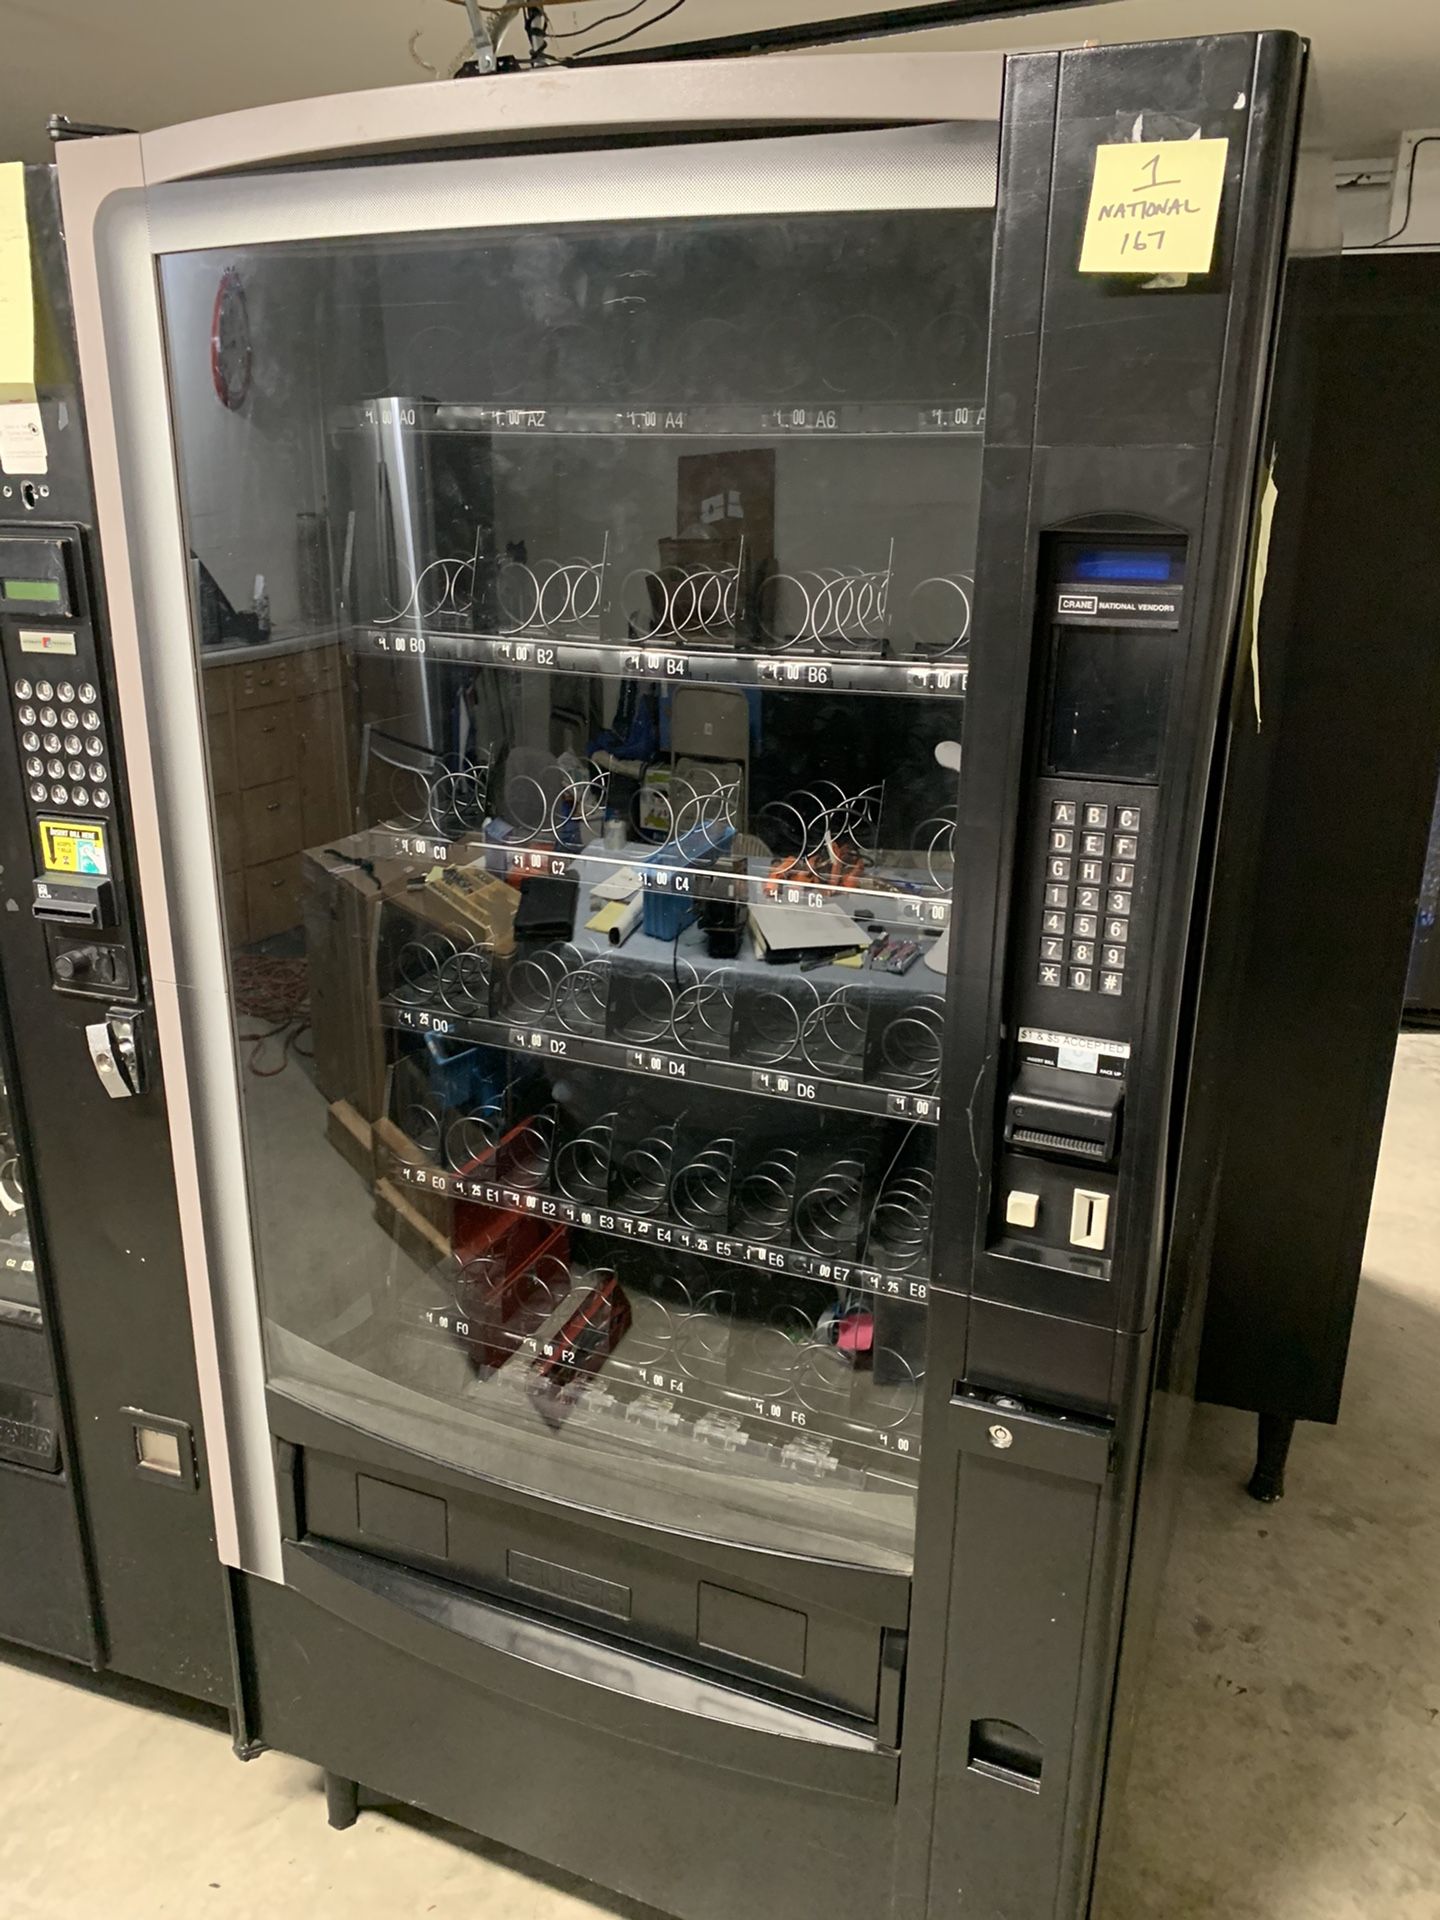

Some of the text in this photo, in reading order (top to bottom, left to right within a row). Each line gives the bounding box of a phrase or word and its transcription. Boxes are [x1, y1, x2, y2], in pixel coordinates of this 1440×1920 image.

[1098, 198, 1201, 221] NATIONAL
[1120, 230, 1166, 255] 167
[400, 409, 416, 426] A0
[527, 412, 545, 428] A2
[665, 413, 684, 429] A4
[816, 411, 836, 428] A6
[976, 407, 986, 426] A
[1062, 599, 1175, 613] CRANE NATIONAL VENDORS
[410, 638, 426, 654] B0
[537, 649, 554, 666] B2
[667, 658, 685, 676] B4
[808, 667, 828, 684] B6
[1056, 805, 1132, 827] A B C
[1054, 833, 1129, 854] D E F
[434, 846, 447, 860] C0
[552, 861, 566, 876] C2
[1052, 860, 1126, 882] G H J
[675, 876, 690, 892] C4
[808, 891, 824, 908] C6
[1052, 887, 1123, 910] 1 2 3
[1048, 914, 1121, 937] 4 5 6
[1046, 941, 1119, 964] 7 8 9
[1074, 970, 1118, 990] 0 #
[433, 1018, 448, 1033] D0
[550, 1039, 567, 1055] D2
[1063, 1037, 1125, 1053] ACCEPTED
[669, 1060, 686, 1077] D4
[797, 1082, 816, 1099] D6
[432, 1176, 446, 1190] E0
[486, 1189, 500, 1203] E1
[542, 1201, 556, 1216] E2
[600, 1216, 615, 1230] E3
[657, 1228, 672, 1243] E4
[716, 1242, 732, 1257] E5
[768, 1252, 785, 1267] E6
[833, 1266, 850, 1281] E7
[909, 1284, 927, 1299] E8
[456, 1321, 469, 1335] F0
[562, 1349, 575, 1364] F2
[670, 1379, 684, 1393] F4
[791, 1410, 806, 1426] F6
